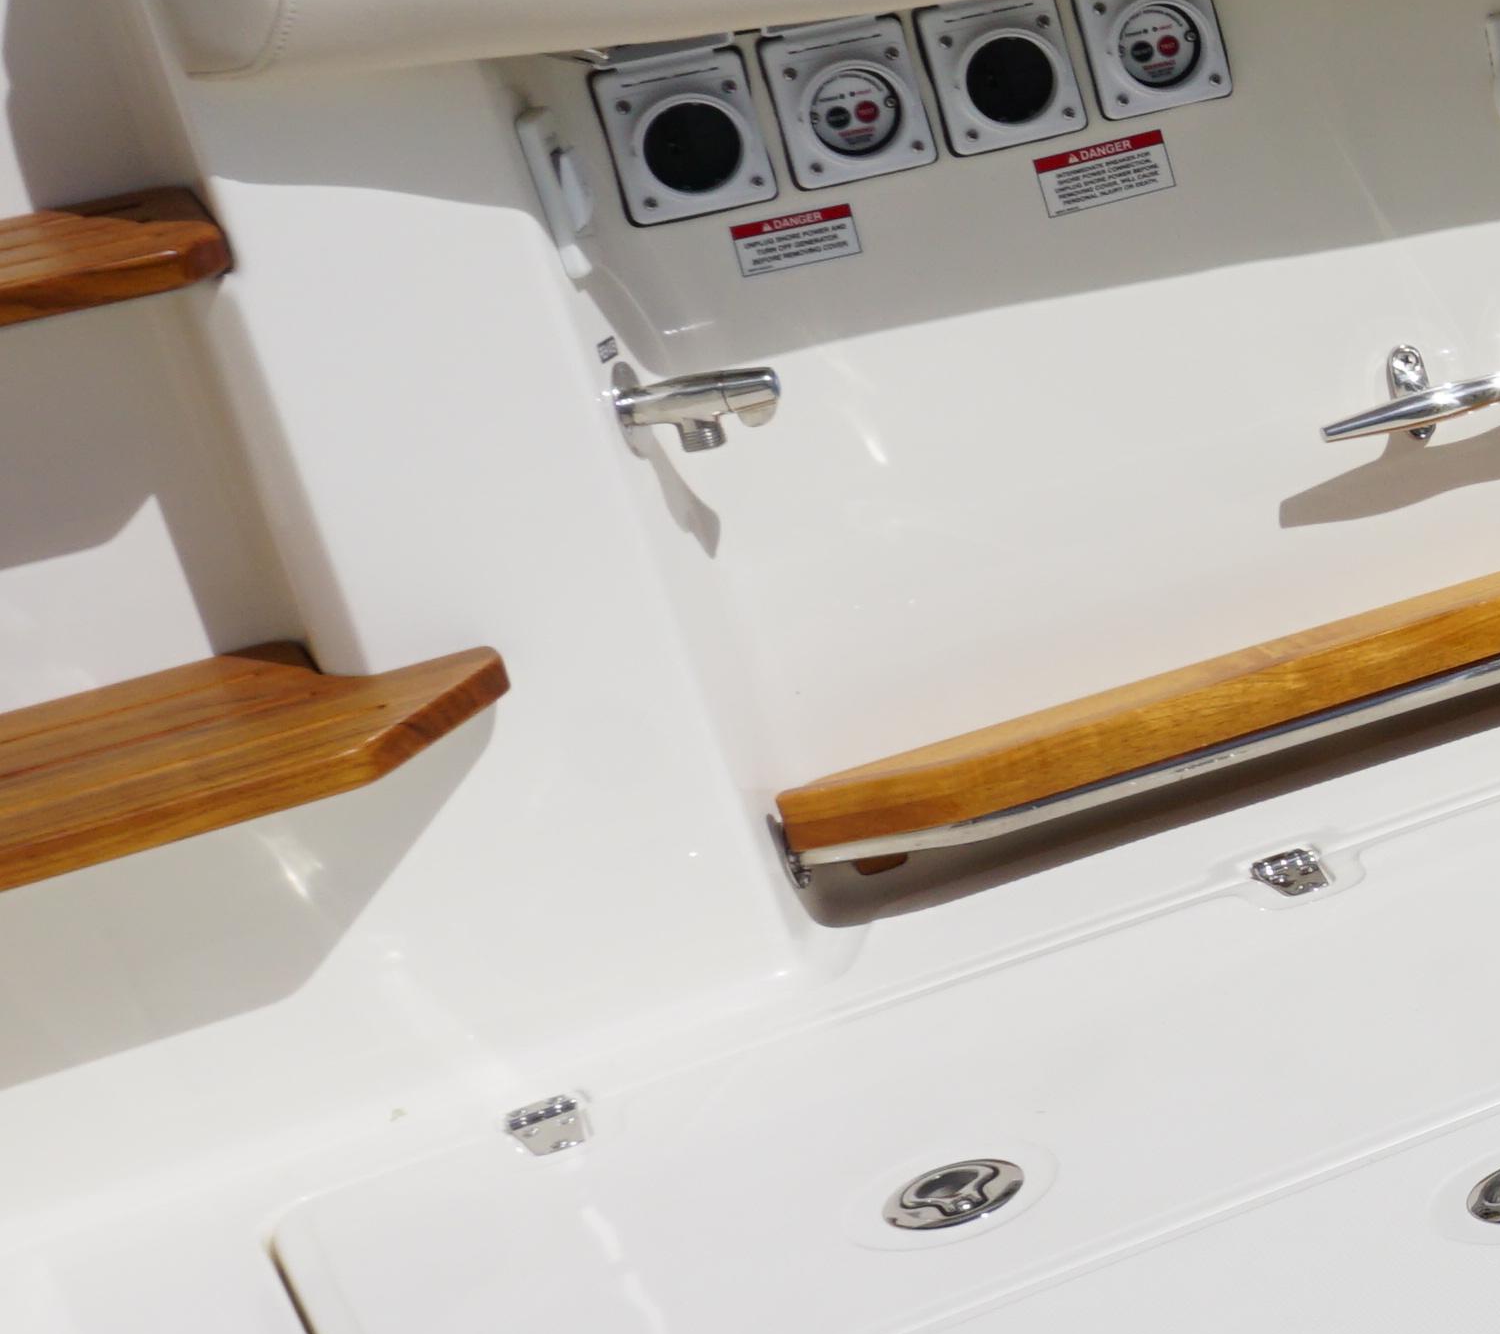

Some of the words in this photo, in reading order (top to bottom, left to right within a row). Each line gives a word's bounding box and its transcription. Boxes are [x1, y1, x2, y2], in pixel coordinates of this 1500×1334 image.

[1079, 139, 1132, 161] DANGER
[1081, 169, 1106, 179] POWER
[1107, 170, 1132, 180] POWER
[1137, 170, 1160, 180] CAUSE
[773, 211, 823, 230] DANGER
[831, 223, 847, 231] AND
